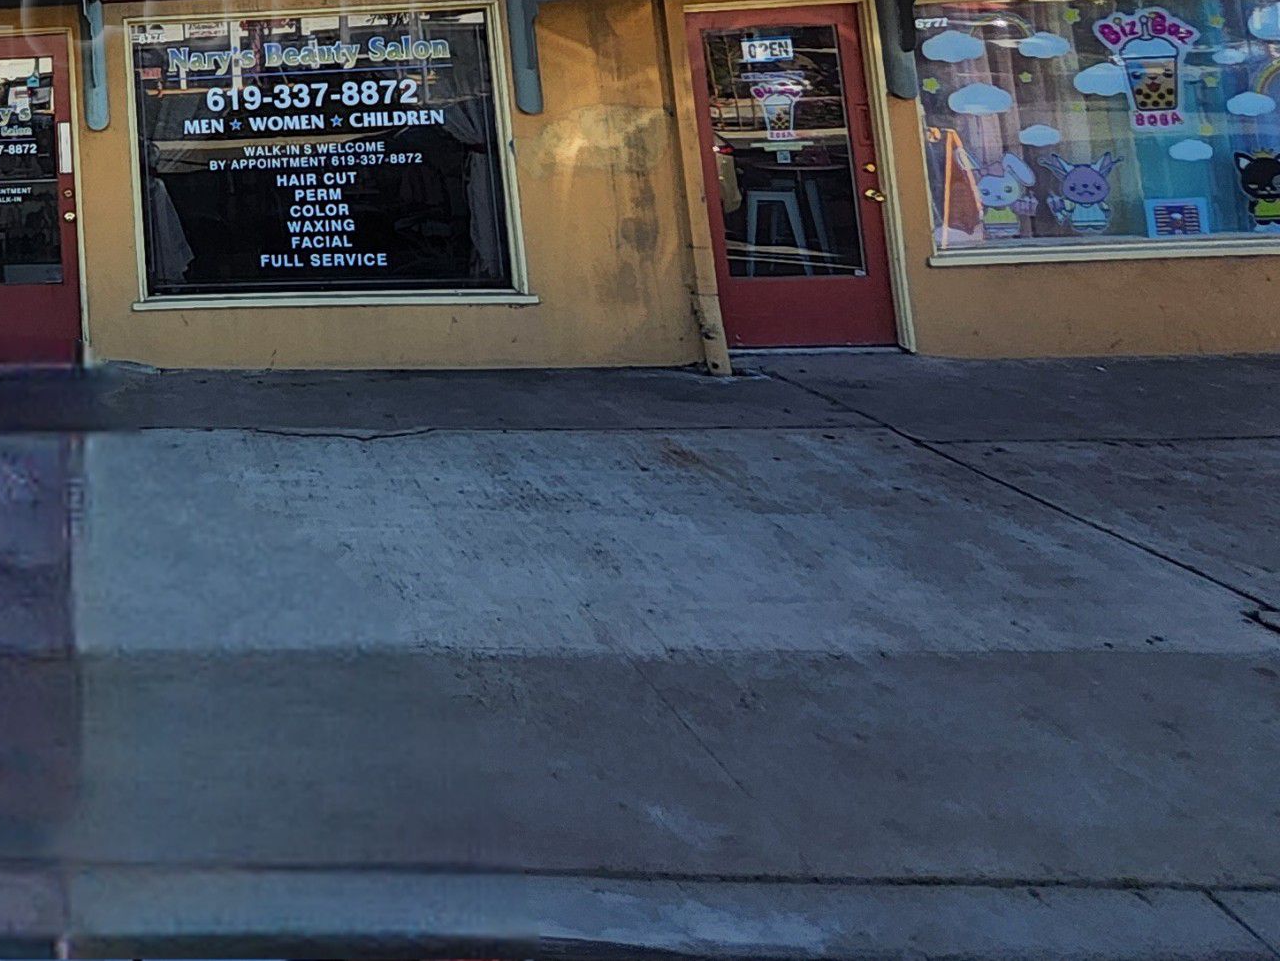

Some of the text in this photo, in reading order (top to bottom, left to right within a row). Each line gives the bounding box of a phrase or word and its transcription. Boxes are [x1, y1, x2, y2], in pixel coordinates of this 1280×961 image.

[166, 36, 450, 76] Nary's Beauty Salon
[748, 41, 790, 59] OPEN
[206, 79, 418, 112] 619-337-8872
[184, 109, 445, 135] MEN WOMEN CHILDREN
[316, 141, 386, 154] WELCOME
[209, 153, 423, 171] BY APPOINTMENT 619-337-8872
[276, 171, 357, 187] HAIR CUT
[294, 188, 342, 201] PERM
[289, 203, 349, 217] COLOR
[286, 219, 355, 233] WAXING
[291, 235, 353, 249] FACIAL
[260, 253, 388, 267] FULL SERVICE
